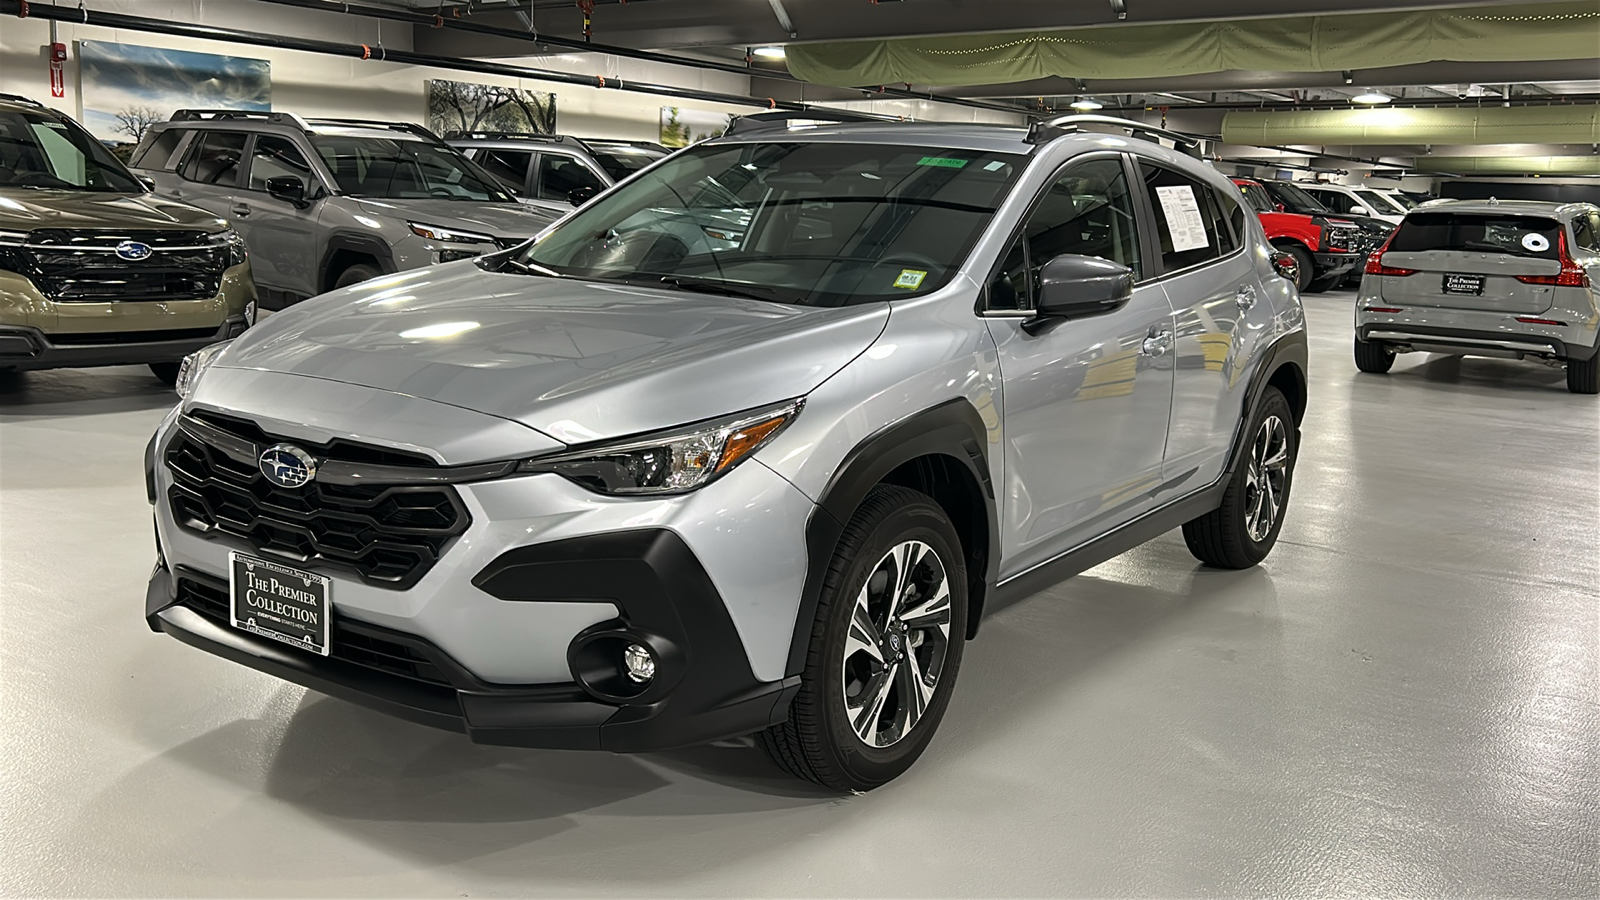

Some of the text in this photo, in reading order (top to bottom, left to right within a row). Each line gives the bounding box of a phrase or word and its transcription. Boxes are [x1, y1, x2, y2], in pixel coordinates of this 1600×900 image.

[245, 571, 317, 606] THE PREMIER
[246, 589, 318, 625] COLLECTION
[257, 611, 281, 623] EVERYTHING
